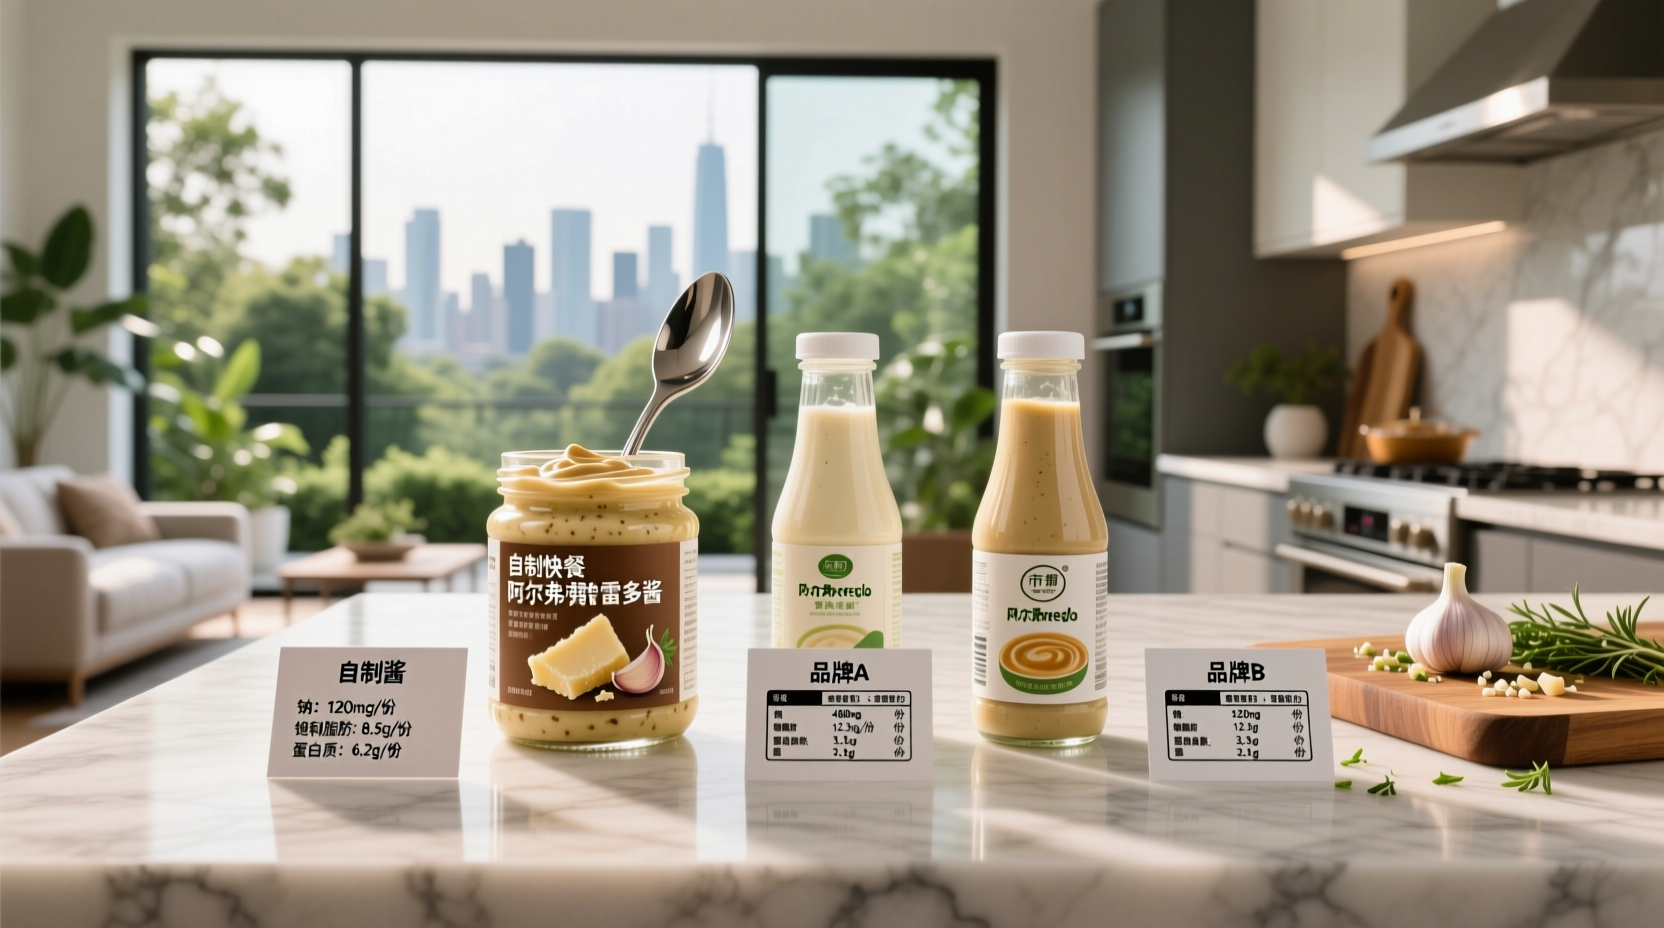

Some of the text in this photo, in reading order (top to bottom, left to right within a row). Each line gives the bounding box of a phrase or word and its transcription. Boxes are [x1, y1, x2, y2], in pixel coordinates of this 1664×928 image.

[508, 553, 586, 579] 自制快餐
[338, 659, 407, 685] 自制酱
[810, 660, 870, 684] 品牌A
[1207, 660, 1266, 684] 品牌B
